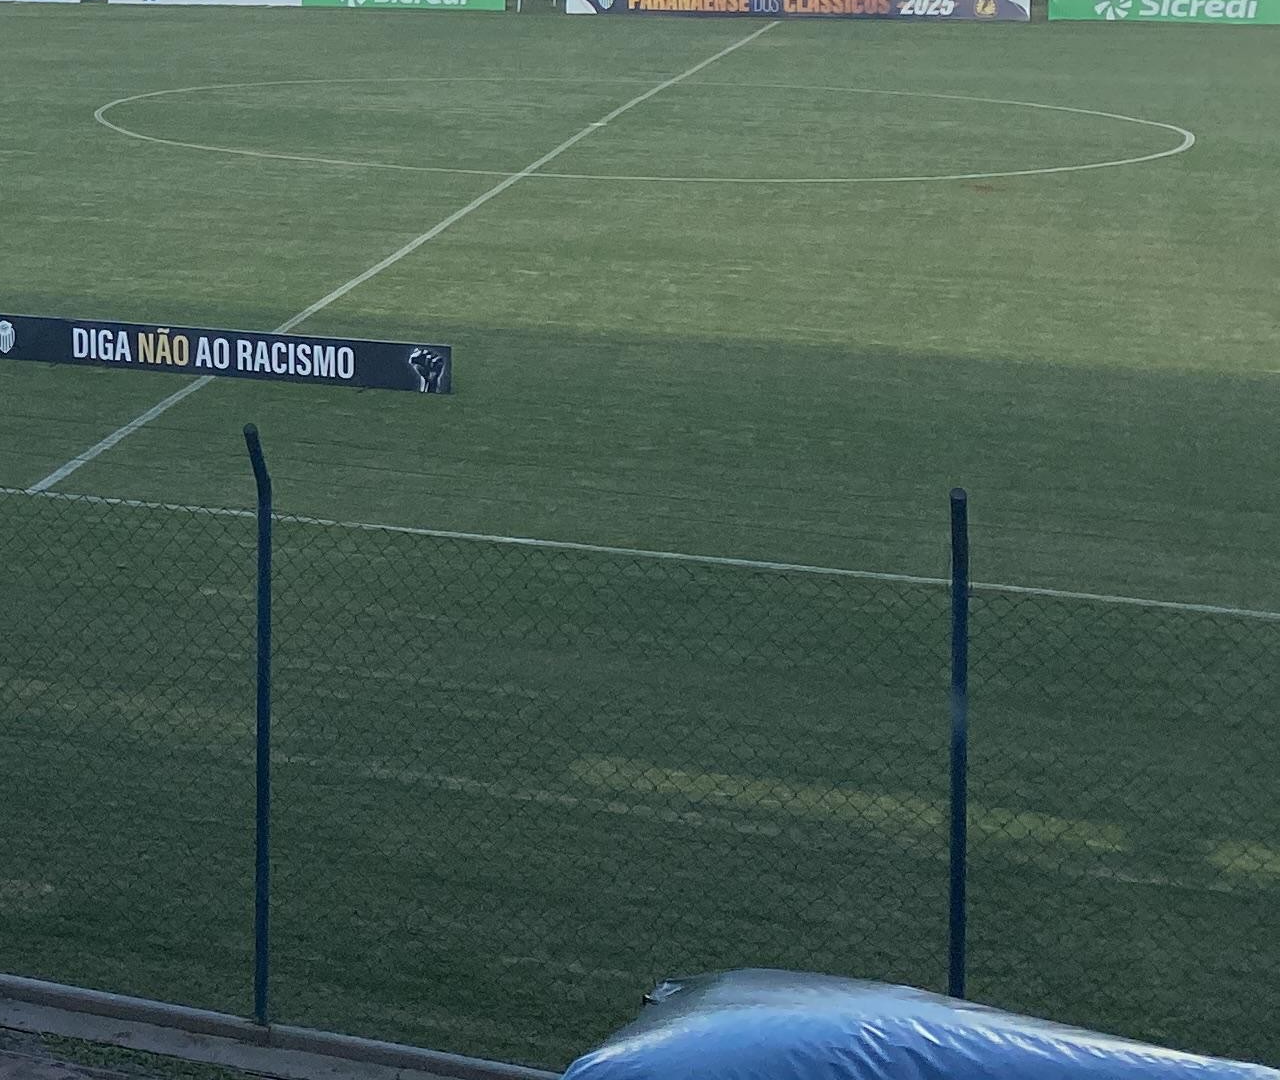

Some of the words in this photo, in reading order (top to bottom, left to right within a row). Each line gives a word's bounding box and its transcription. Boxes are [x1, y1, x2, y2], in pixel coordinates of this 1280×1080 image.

[72, 327, 132, 362] DIGA
[138, 328, 189, 366] NÃO
[195, 336, 230, 370] AO
[237, 339, 355, 379] RACISMO
